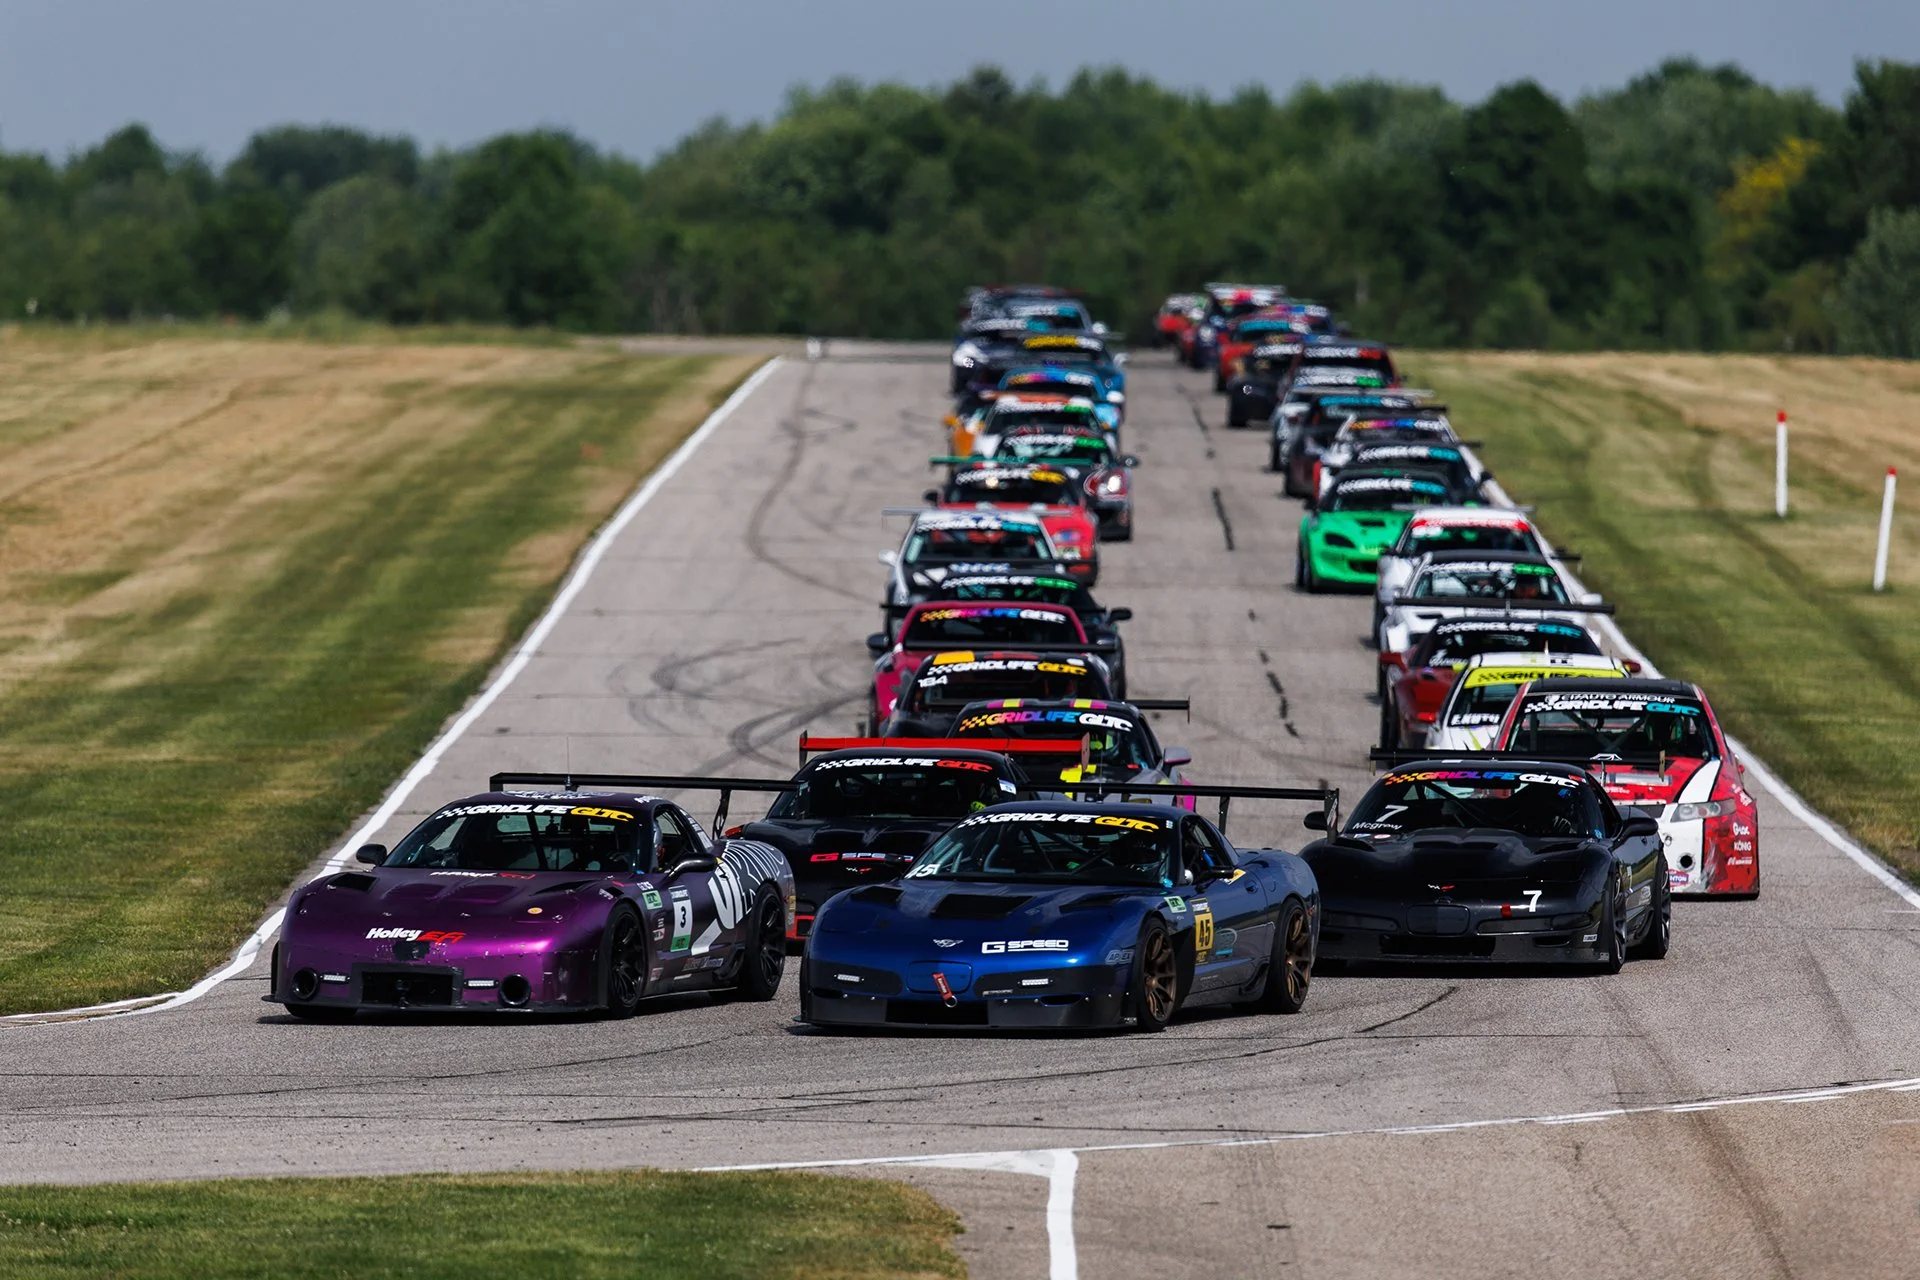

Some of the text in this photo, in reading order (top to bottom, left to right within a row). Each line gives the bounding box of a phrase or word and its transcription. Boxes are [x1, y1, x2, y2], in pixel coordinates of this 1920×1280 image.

[957, 660, 1088, 676] GRIDLIFE GLTC
[1553, 700, 1701, 717] GRIDLIFE GLTC
[984, 711, 1133, 732] GRIDLIFE GLTC
[844, 758, 993, 773] GRIDLIFE GLTC
[1416, 771, 1580, 789] GRIDLIFE GLTC
[466, 804, 635, 822] GRIDLIFE GLTC
[1376, 804, 1408, 823] 7
[989, 813, 1101, 824] GRIDLIFE
[1094, 816, 1160, 833] GLTC
[810, 852, 914, 862] G SPED
[1523, 890, 1542, 912] 7
[680, 906, 687, 928] 3
[365, 927, 467, 944] Holley EFI
[1199, 919, 1211, 947] 45
[981, 939, 1069, 954] G SPEED
